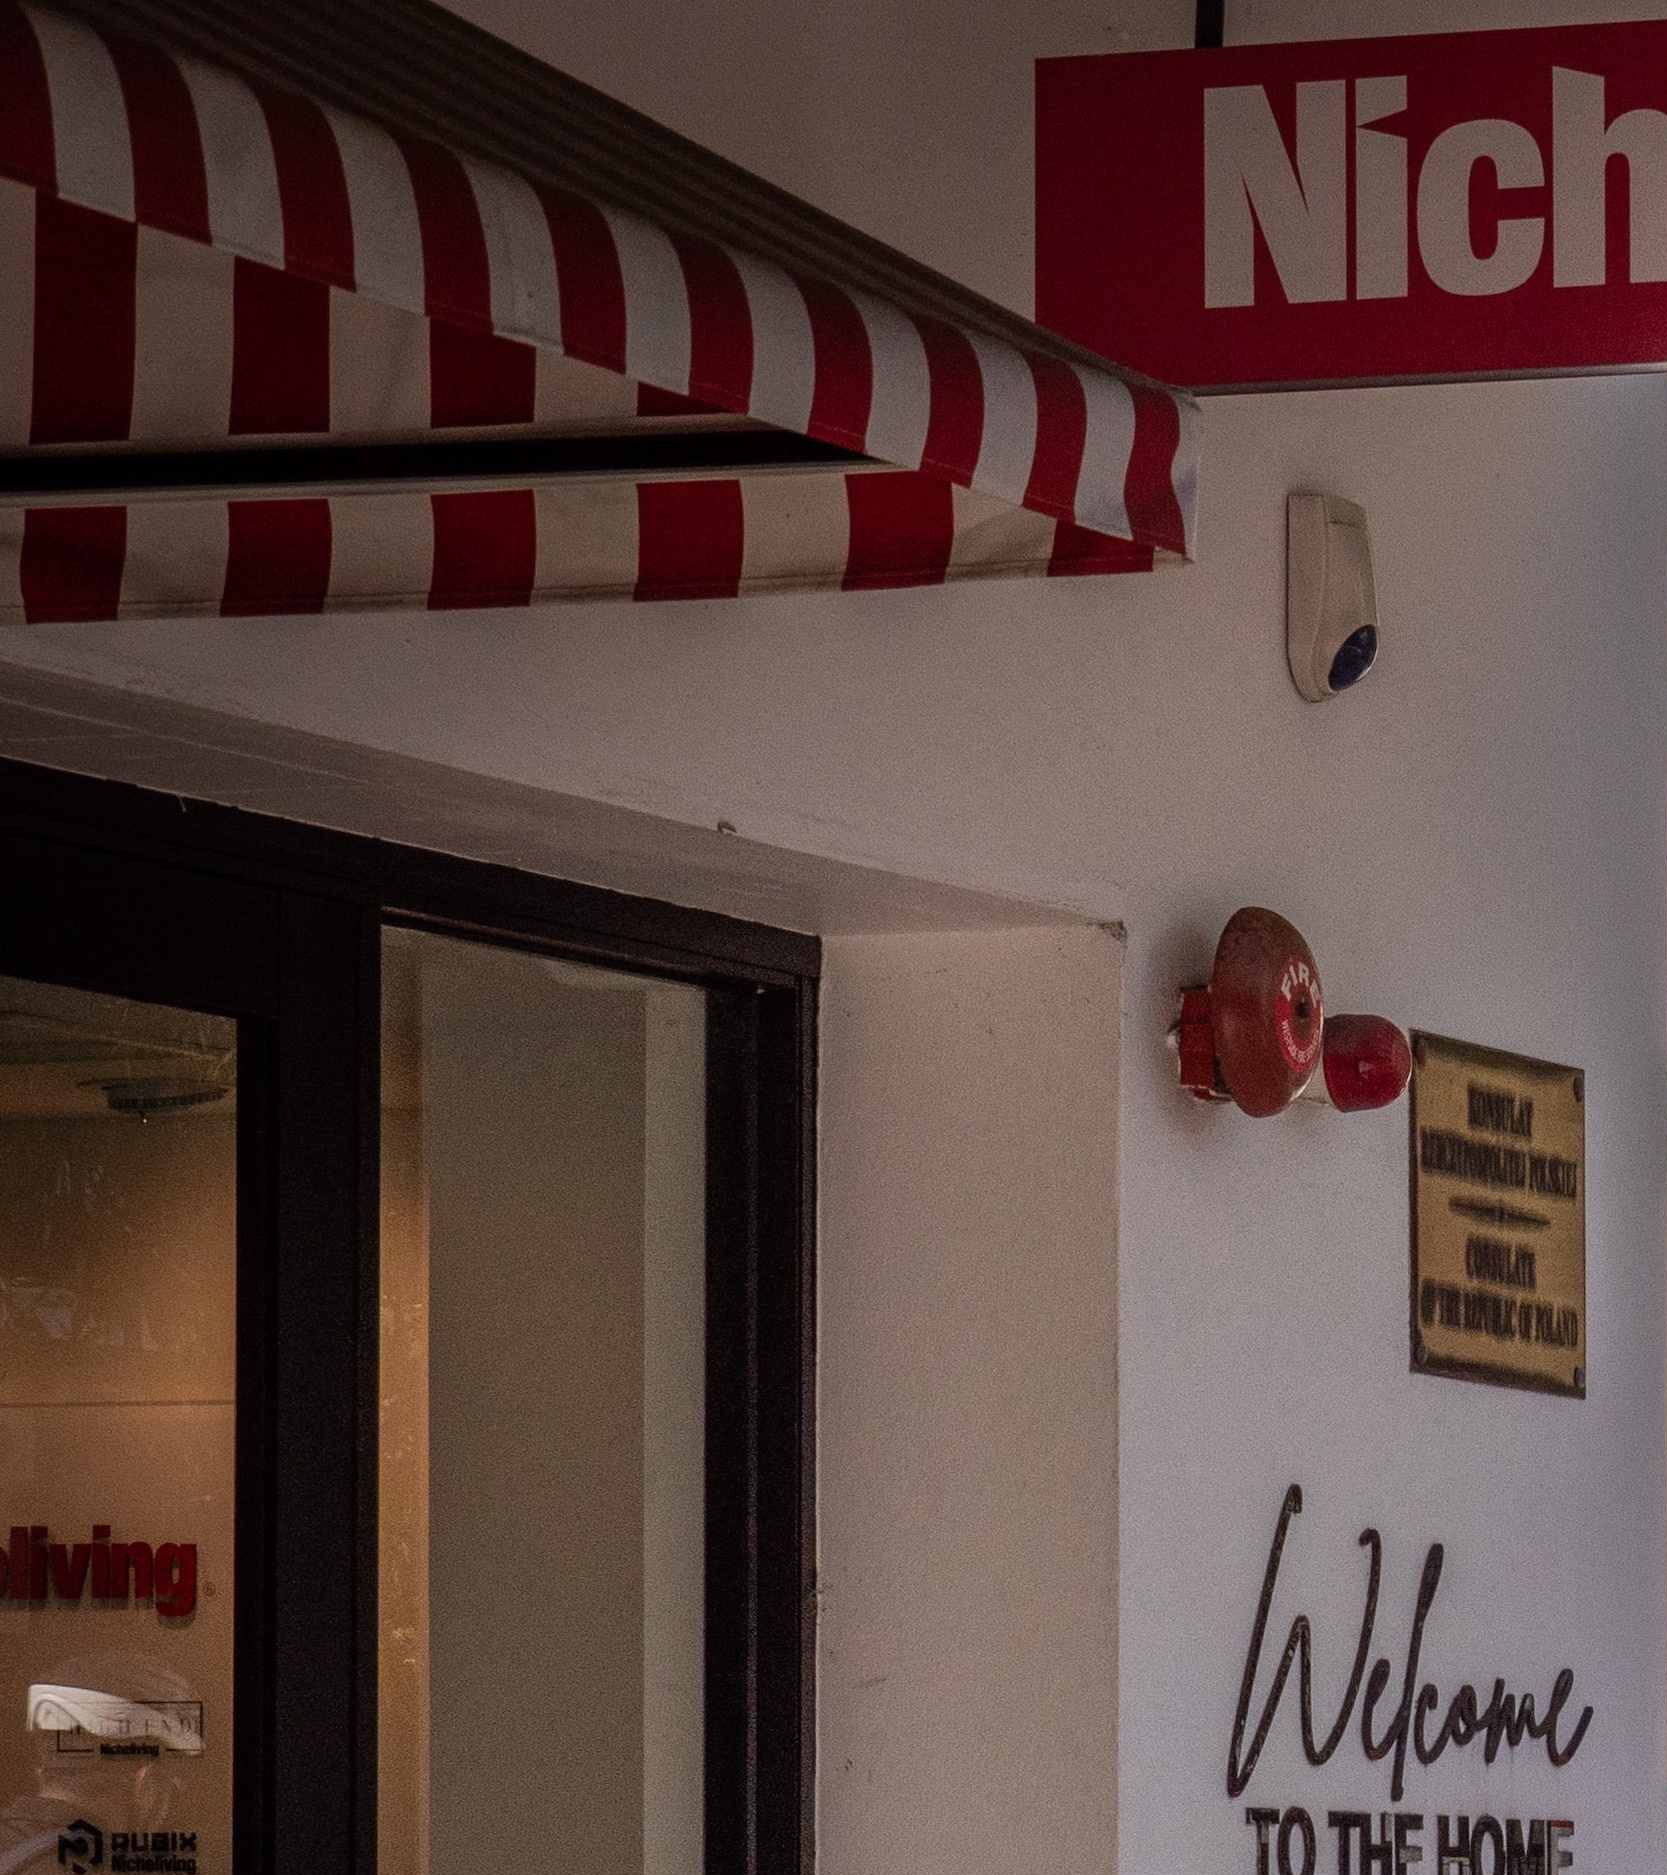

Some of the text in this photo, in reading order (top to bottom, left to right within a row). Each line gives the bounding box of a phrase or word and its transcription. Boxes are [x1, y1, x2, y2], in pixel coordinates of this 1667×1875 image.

[0, 1524, 197, 1617] living
[1227, 1483, 1594, 1801] Welcome
[111, 1832, 197, 1852] RUBIX
[111, 1855, 197, 1874] Nicheliving
